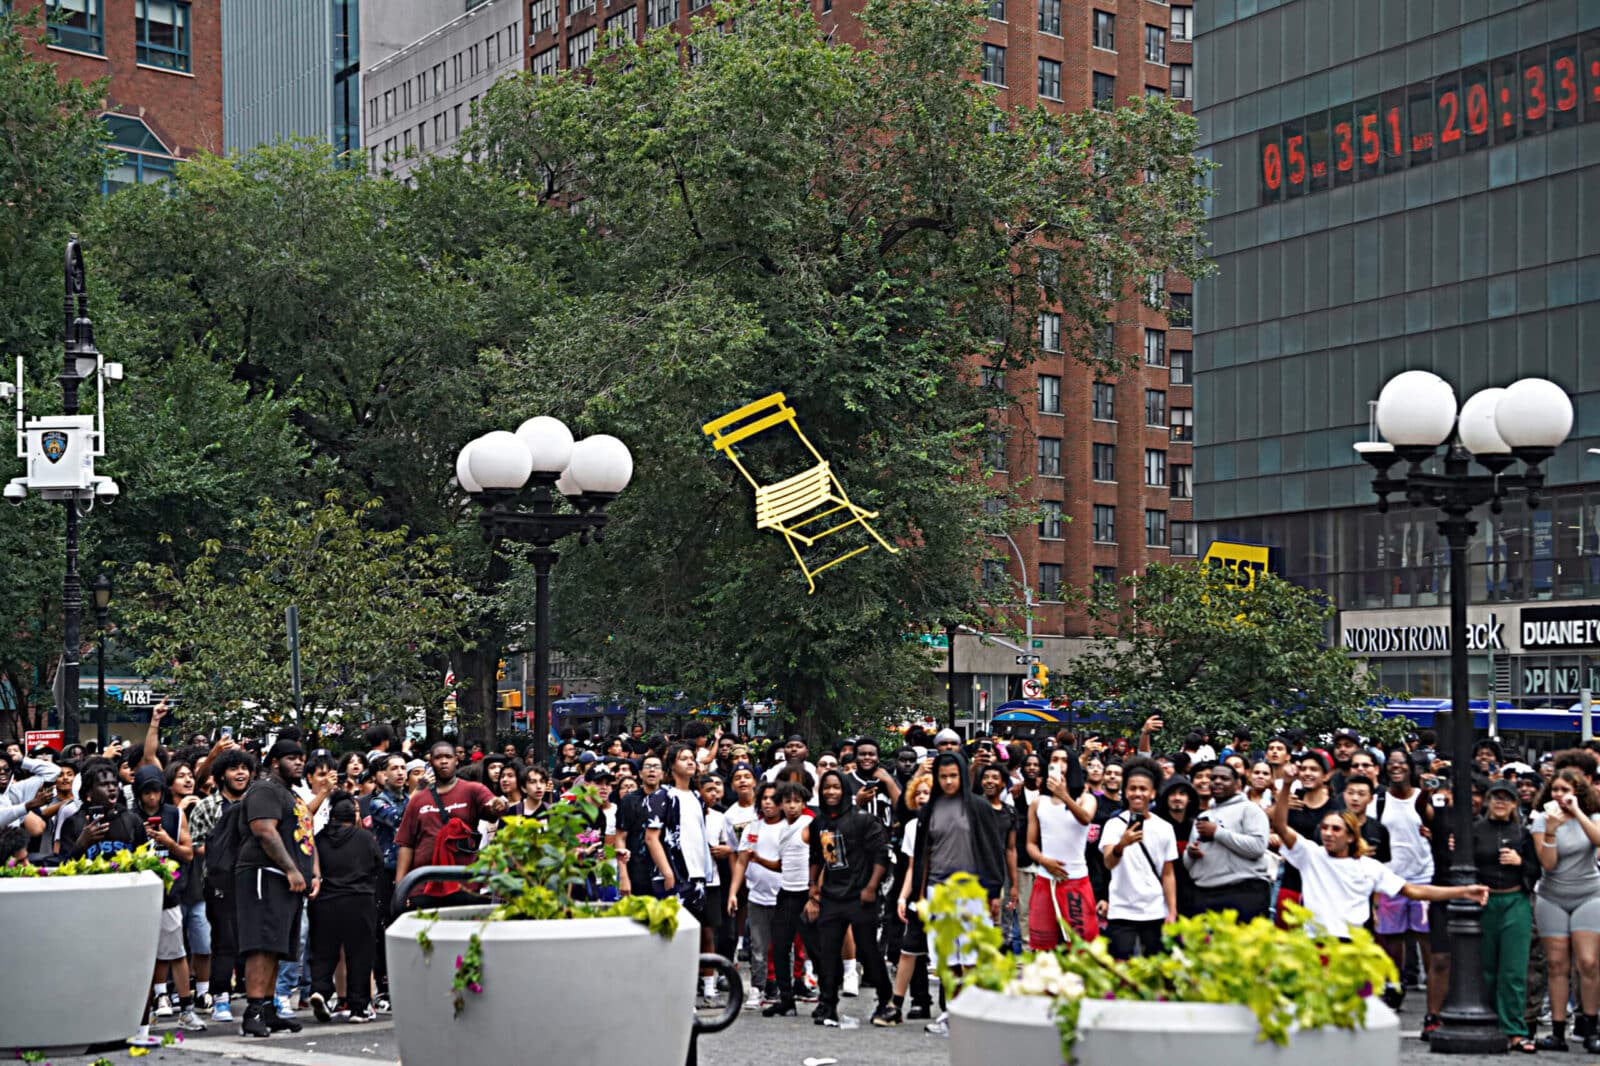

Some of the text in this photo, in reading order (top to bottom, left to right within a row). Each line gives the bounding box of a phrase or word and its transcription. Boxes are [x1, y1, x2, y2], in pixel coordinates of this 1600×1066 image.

[1335, 107, 1401, 172] 351
[1343, 625, 1448, 652] NORDSTROM
[123, 690, 152, 704] AT&T
